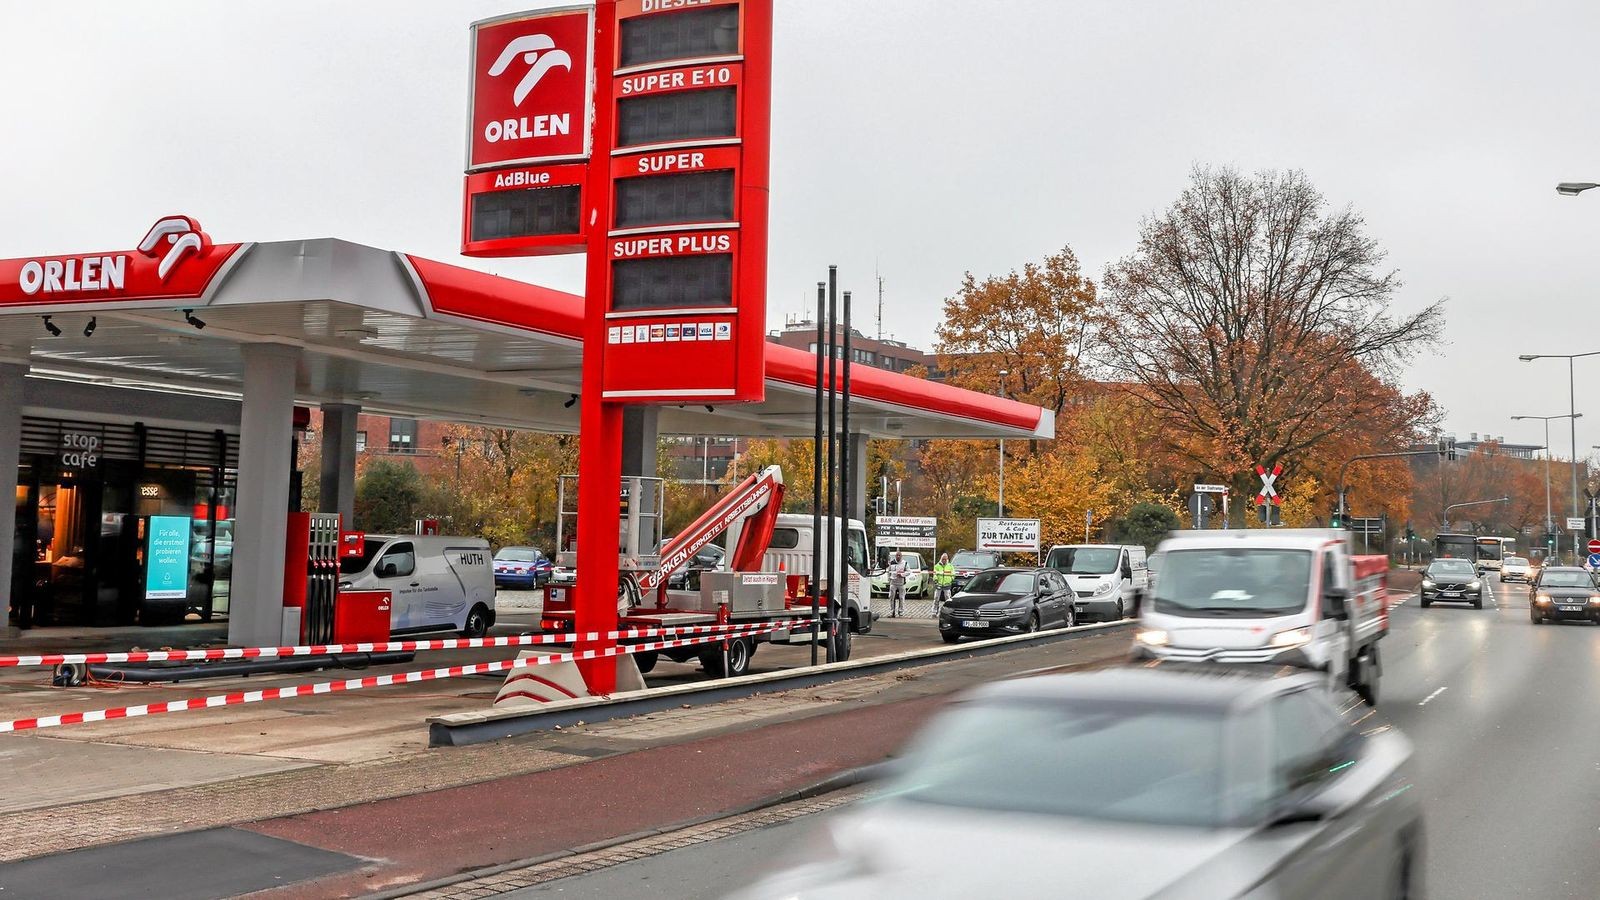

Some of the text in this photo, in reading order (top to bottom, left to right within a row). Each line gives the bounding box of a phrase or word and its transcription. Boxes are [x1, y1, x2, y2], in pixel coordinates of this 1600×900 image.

[642, 0, 711, 14] DIES
[622, 68, 730, 94] SUPER E10
[485, 113, 570, 143] ORLEN
[638, 152, 704, 172] SUPER
[494, 171, 550, 188] AdBlue
[614, 235, 730, 257] SUPER PLUS
[19, 256, 125, 294] ORLEN
[64, 432, 98, 452] stop
[62, 451, 96, 468] cafe
[460, 553, 484, 565] HUTH
[648, 548, 688, 588] GERKEN
[688, 521, 722, 554] VERMIETET
